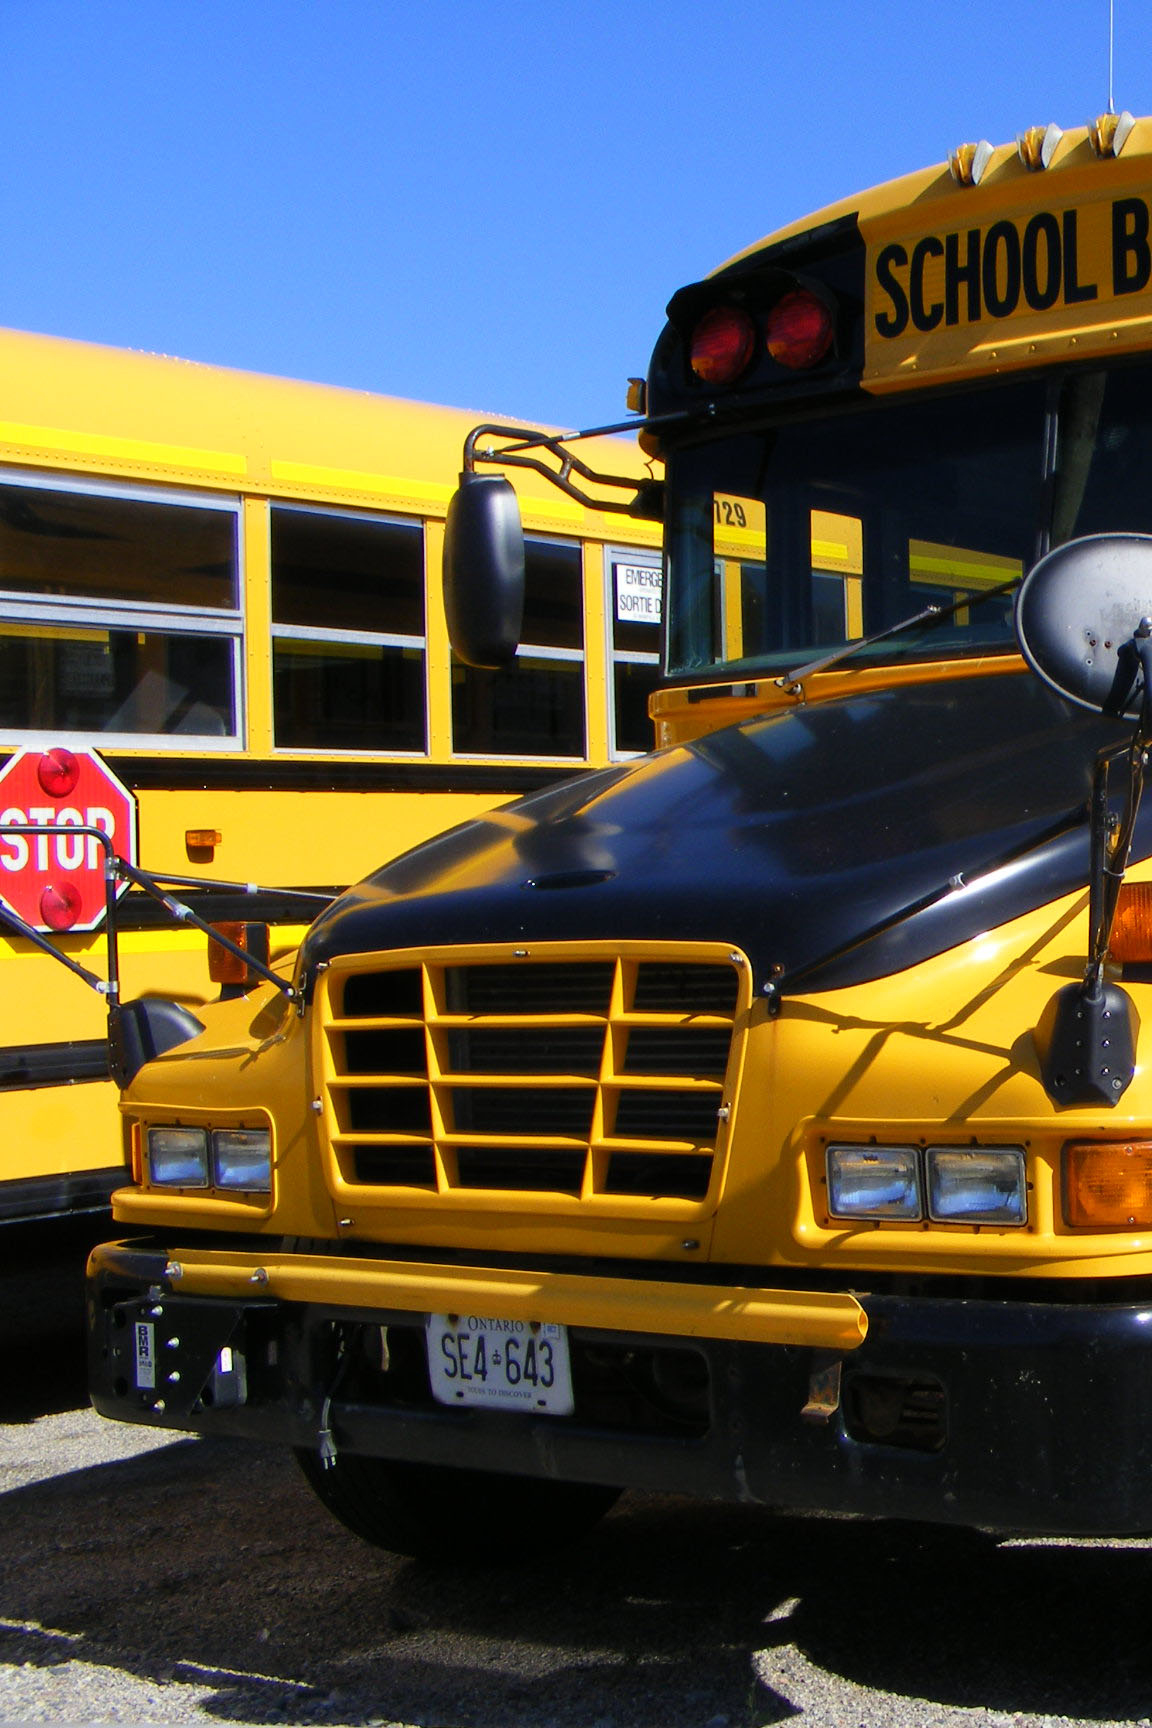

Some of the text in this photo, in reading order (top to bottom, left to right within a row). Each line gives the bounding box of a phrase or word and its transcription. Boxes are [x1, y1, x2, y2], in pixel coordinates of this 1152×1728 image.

[875, 209, 1098, 339] SCHOOL
[620, 594, 653, 614] SORTIE
[0, 807, 116, 872] STOP
[467, 1315, 525, 1333] ONTARIO
